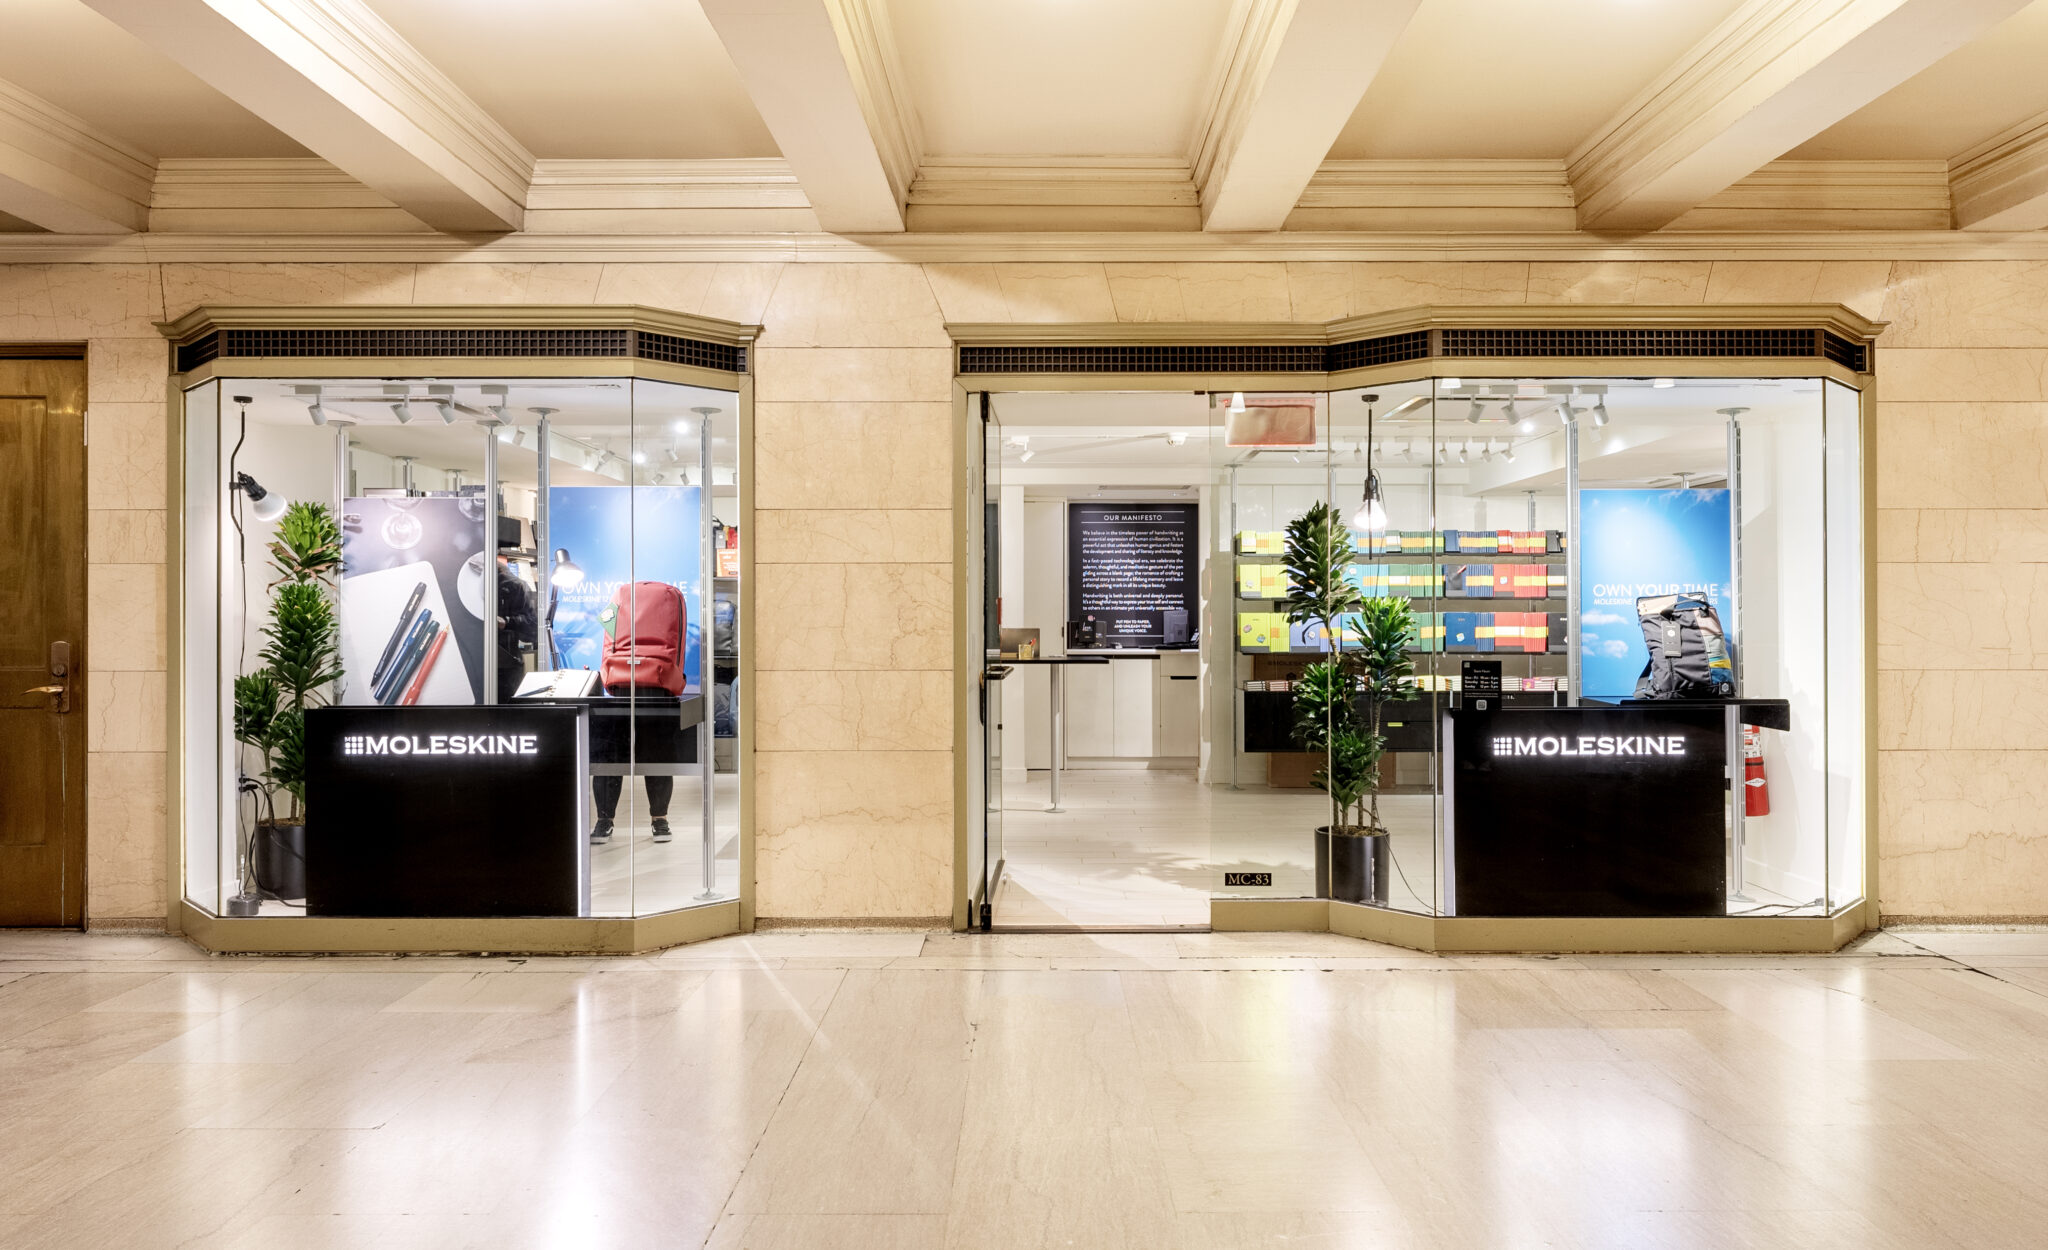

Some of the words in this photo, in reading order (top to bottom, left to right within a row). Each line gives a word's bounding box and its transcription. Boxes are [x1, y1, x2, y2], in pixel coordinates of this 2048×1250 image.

[1592, 583, 1632, 597] OWN
[1635, 583, 1680, 596] YOUR
[1683, 583, 1719, 596] TIME
[365, 735, 538, 754] MOLESKINE
[1514, 736, 1686, 755] MOLESKINE
[1228, 873, 1269, 885] MC-83
